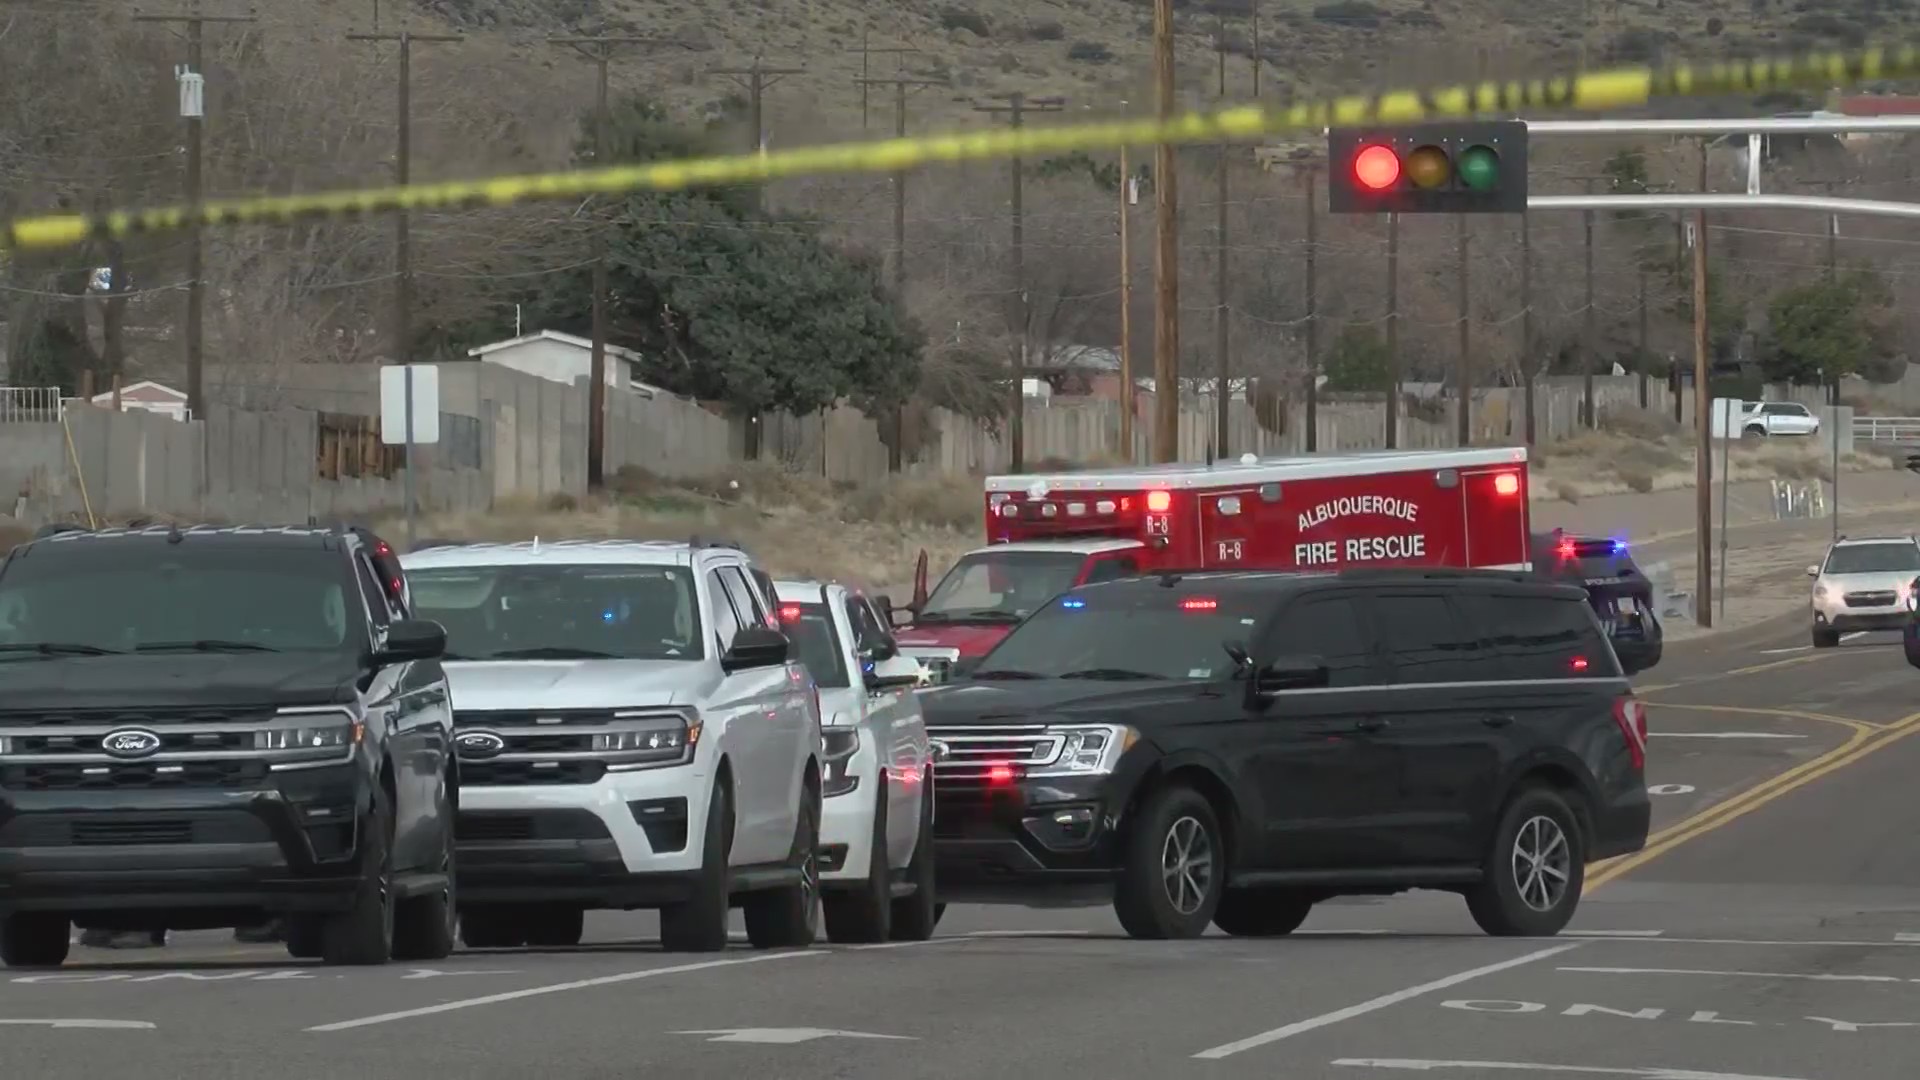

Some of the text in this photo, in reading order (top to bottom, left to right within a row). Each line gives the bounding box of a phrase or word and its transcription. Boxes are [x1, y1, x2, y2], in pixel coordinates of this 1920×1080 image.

[1146, 515, 1169, 534] R-8
[1298, 495, 1419, 532] ALBUQUERQUE
[1219, 541, 1242, 560] R-8
[1295, 534, 1426, 566] FIRE RESCUE
[115, 735, 146, 750] Ford
[1439, 999, 1920, 1031] ONLY
